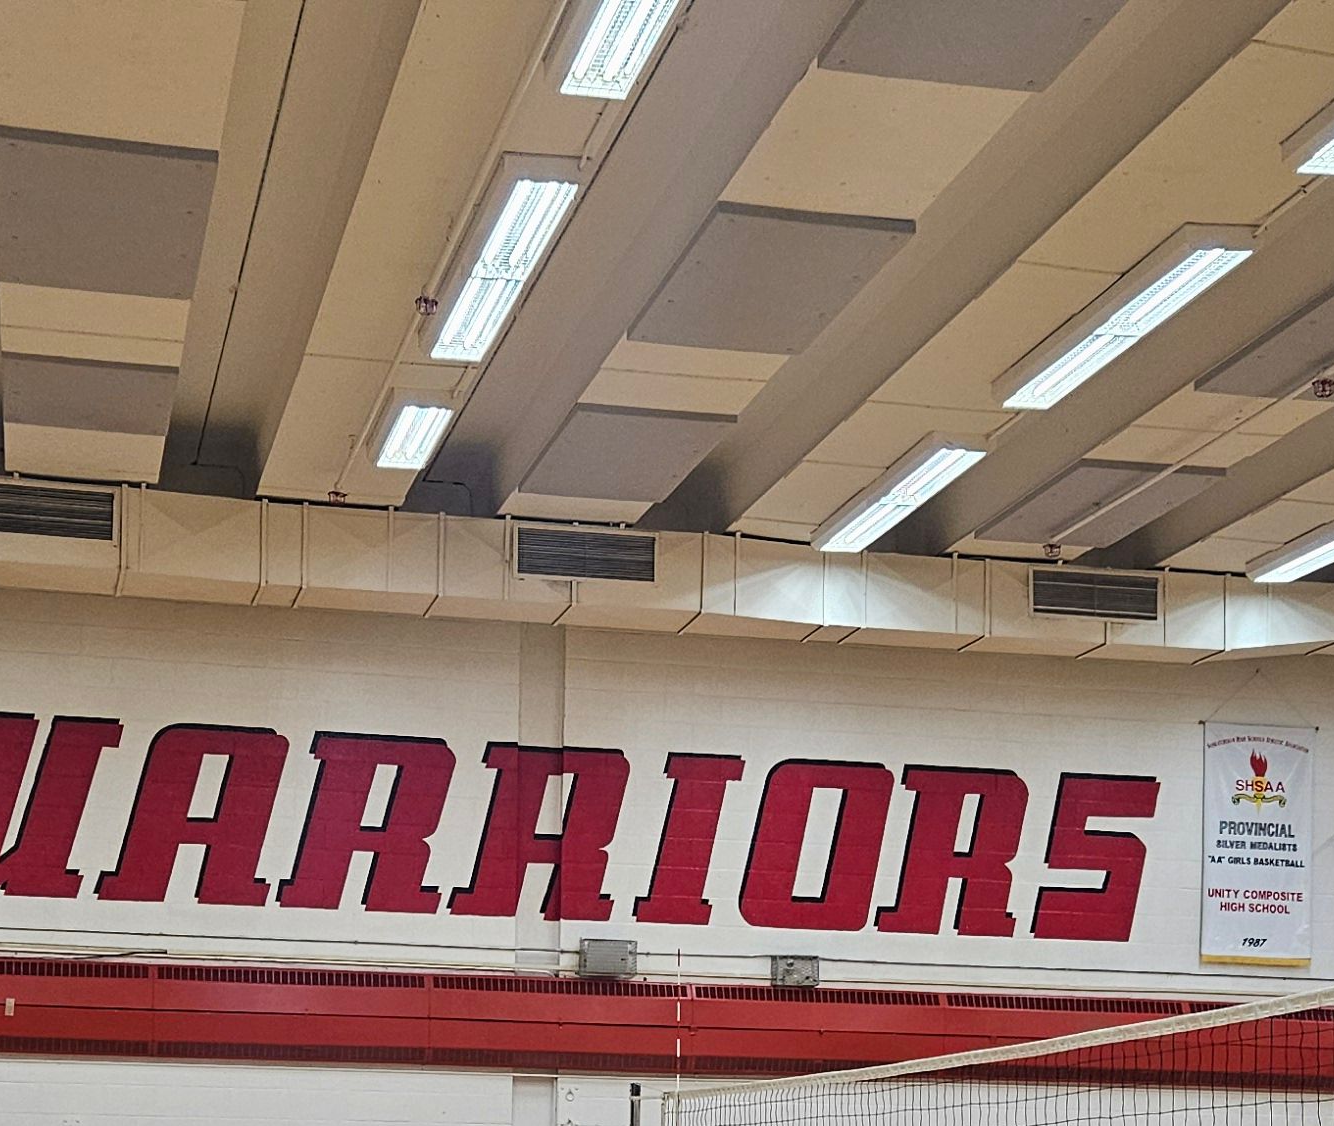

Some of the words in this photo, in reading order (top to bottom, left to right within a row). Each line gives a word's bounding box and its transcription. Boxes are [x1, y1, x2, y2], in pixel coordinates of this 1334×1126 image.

[1235, 779, 1285, 793] SHSAA
[1219, 820, 1295, 838] PROVINCIAL
[1216, 840, 1246, 850] SILVER
[1250, 841, 1298, 852] MEDALISTS
[1227, 856, 1251, 865] GIRLS
[1253, 857, 1305, 868] BASKETBALL
[1207, 888, 1240, 899] UNITY
[1243, 889, 1303, 902] COMPOSITE
[1220, 901, 1245, 912] HIGH
[1248, 903, 1290, 915] SCHOOL
[1242, 937, 1267, 948] 1987
